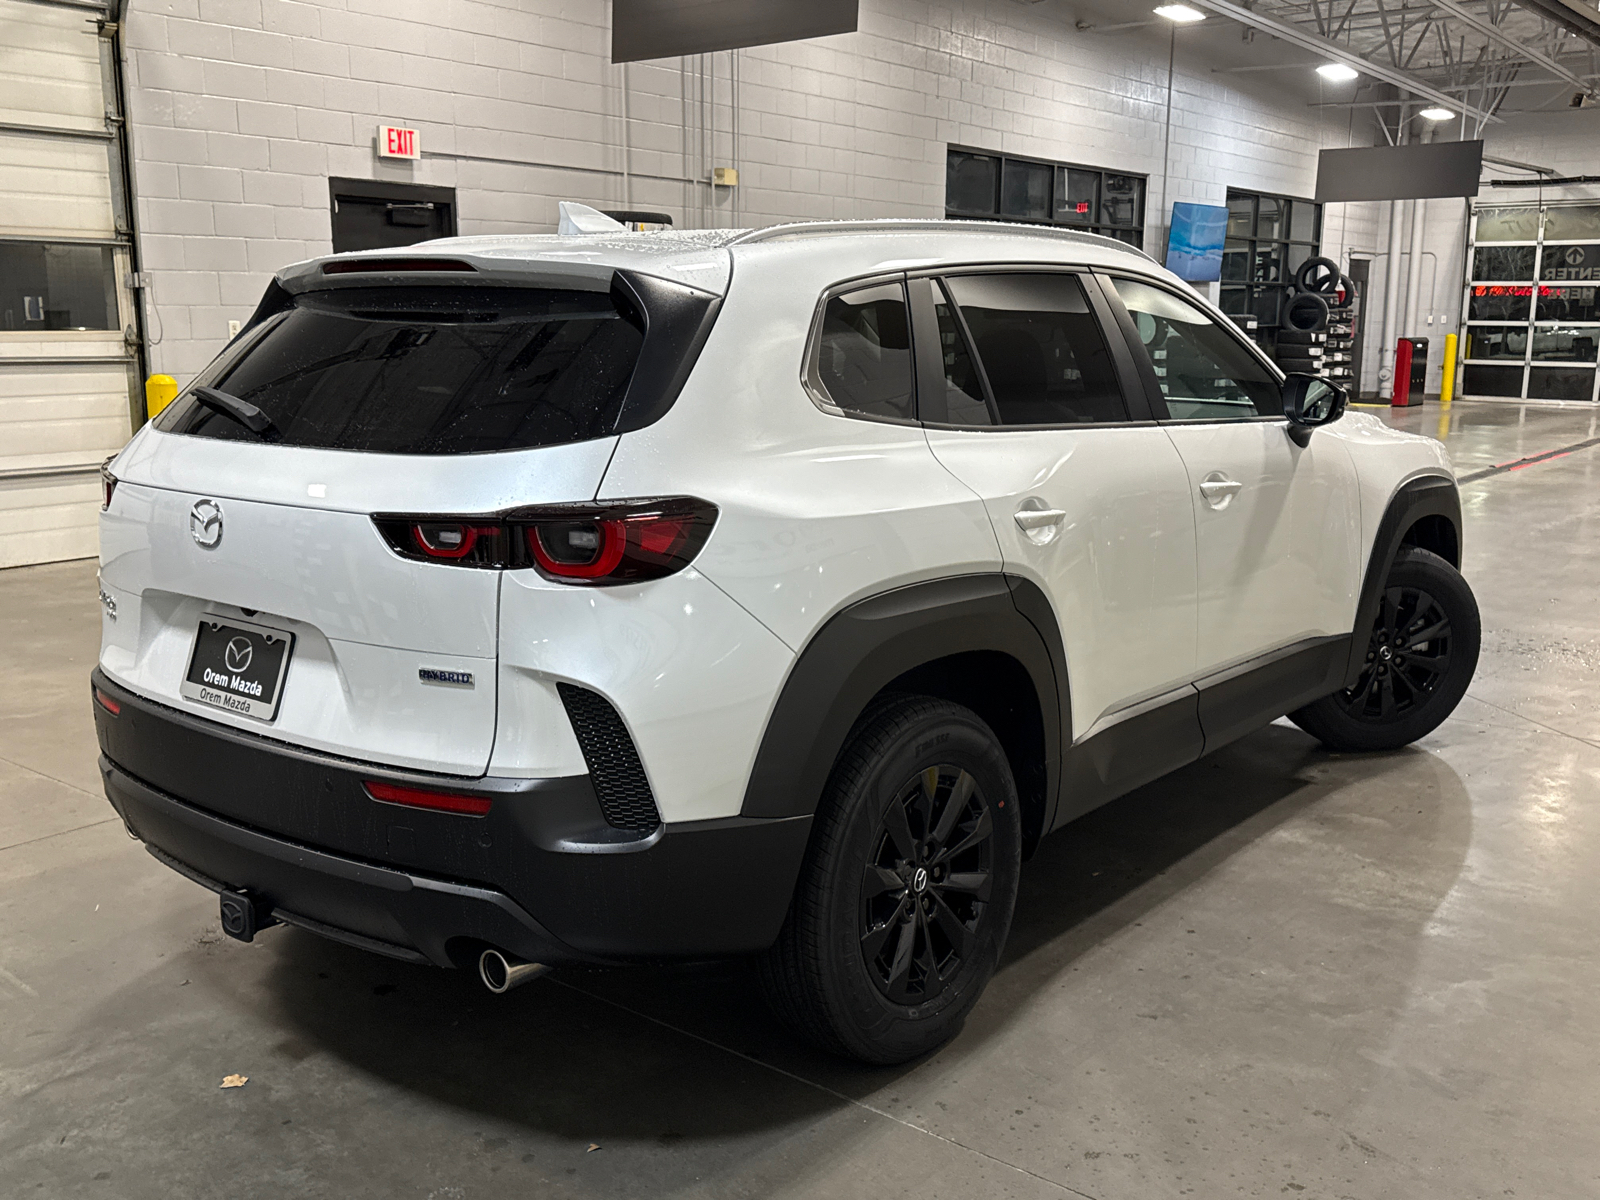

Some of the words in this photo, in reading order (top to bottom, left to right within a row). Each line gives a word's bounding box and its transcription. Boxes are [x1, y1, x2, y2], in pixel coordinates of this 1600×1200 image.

[387, 128, 414, 156] EXIT
[203, 667, 229, 687] Orem
[230, 675, 263, 696] Mazda
[420, 669, 471, 684] HYBRID
[200, 687, 222, 704] Orem
[223, 694, 251, 713] Mazda
